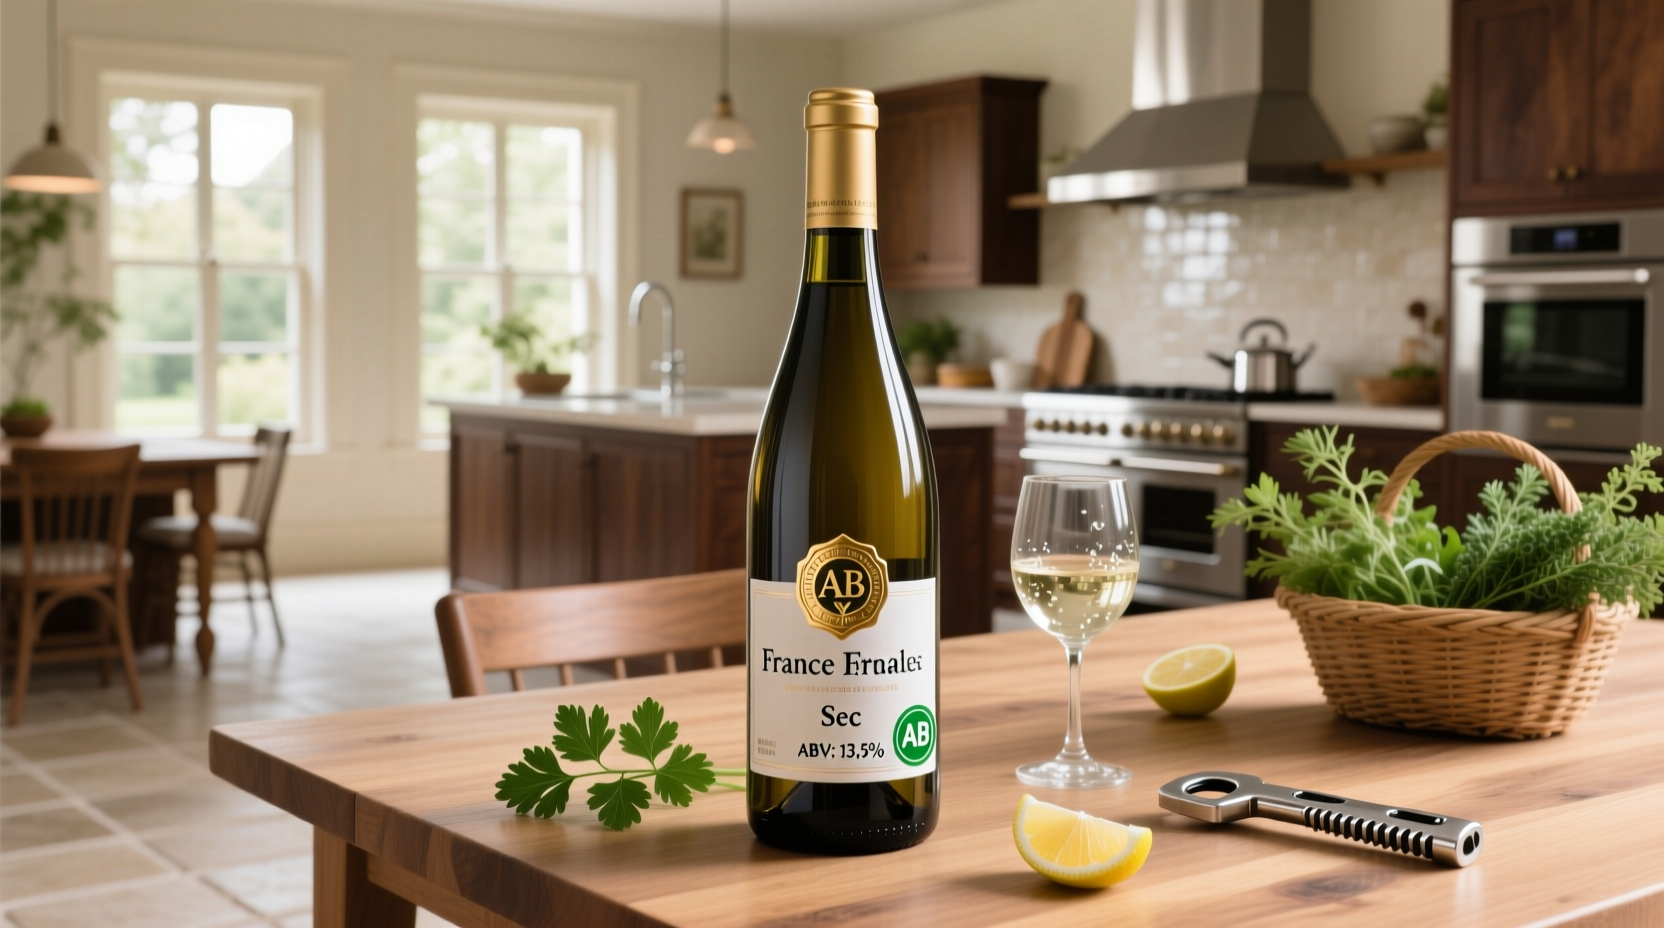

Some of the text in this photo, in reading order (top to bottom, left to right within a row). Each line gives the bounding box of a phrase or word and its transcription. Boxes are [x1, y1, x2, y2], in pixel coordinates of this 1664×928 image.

[818, 569, 865, 599] AB
[762, 648, 835, 676] France
[821, 704, 862, 727] Sec
[902, 721, 930, 748] AB
[797, 742, 836, 759] ABV:
